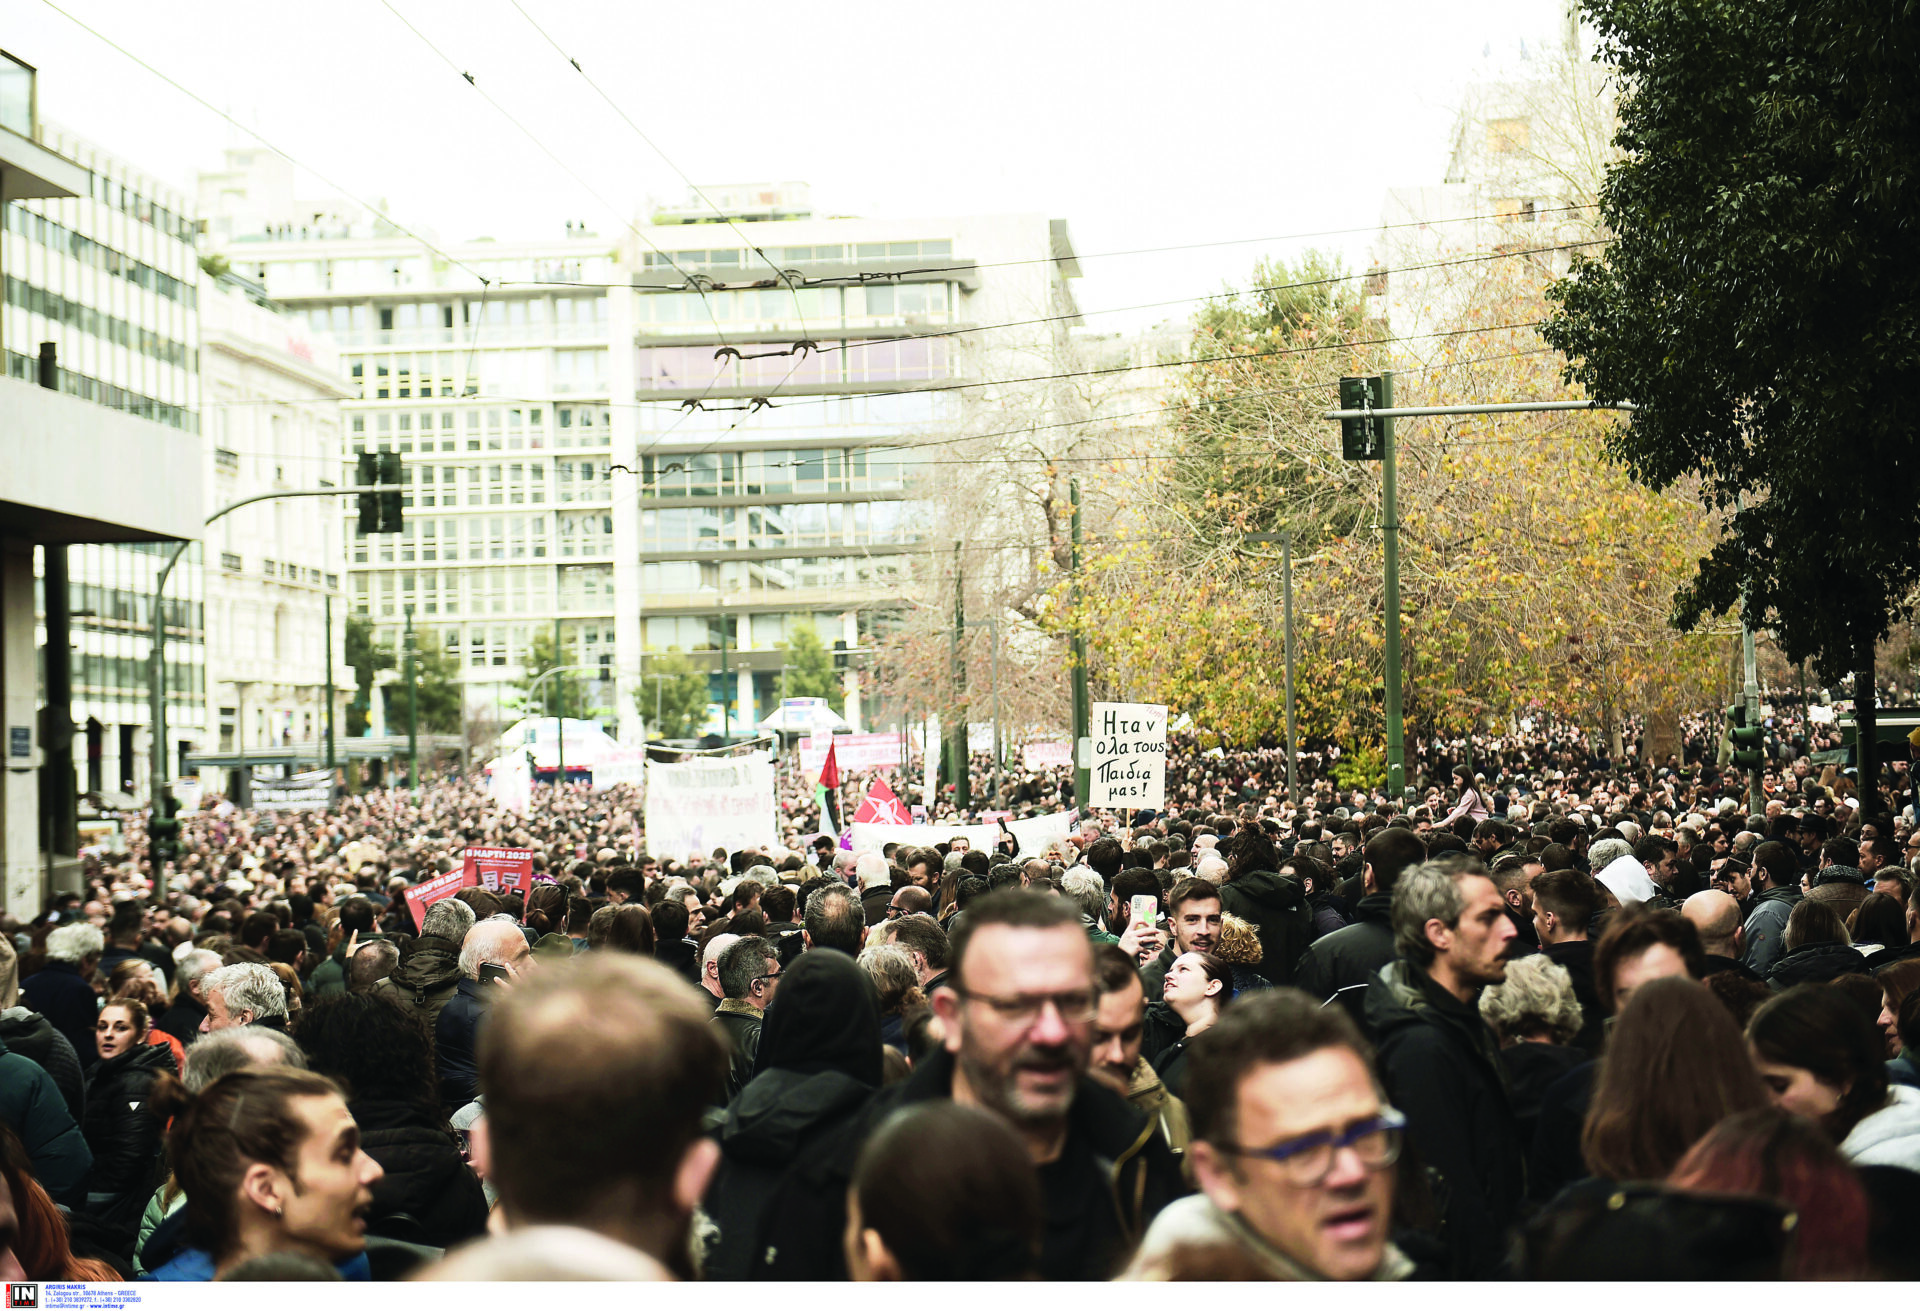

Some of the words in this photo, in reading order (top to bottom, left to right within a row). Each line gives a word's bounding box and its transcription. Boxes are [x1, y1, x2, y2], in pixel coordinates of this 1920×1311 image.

[1104, 710, 1155, 735] Ηταν
[1133, 741, 1165, 753] τους
[473, 849, 506, 859] ΜΑΡΤΗ
[506, 851, 532, 860] 2025
